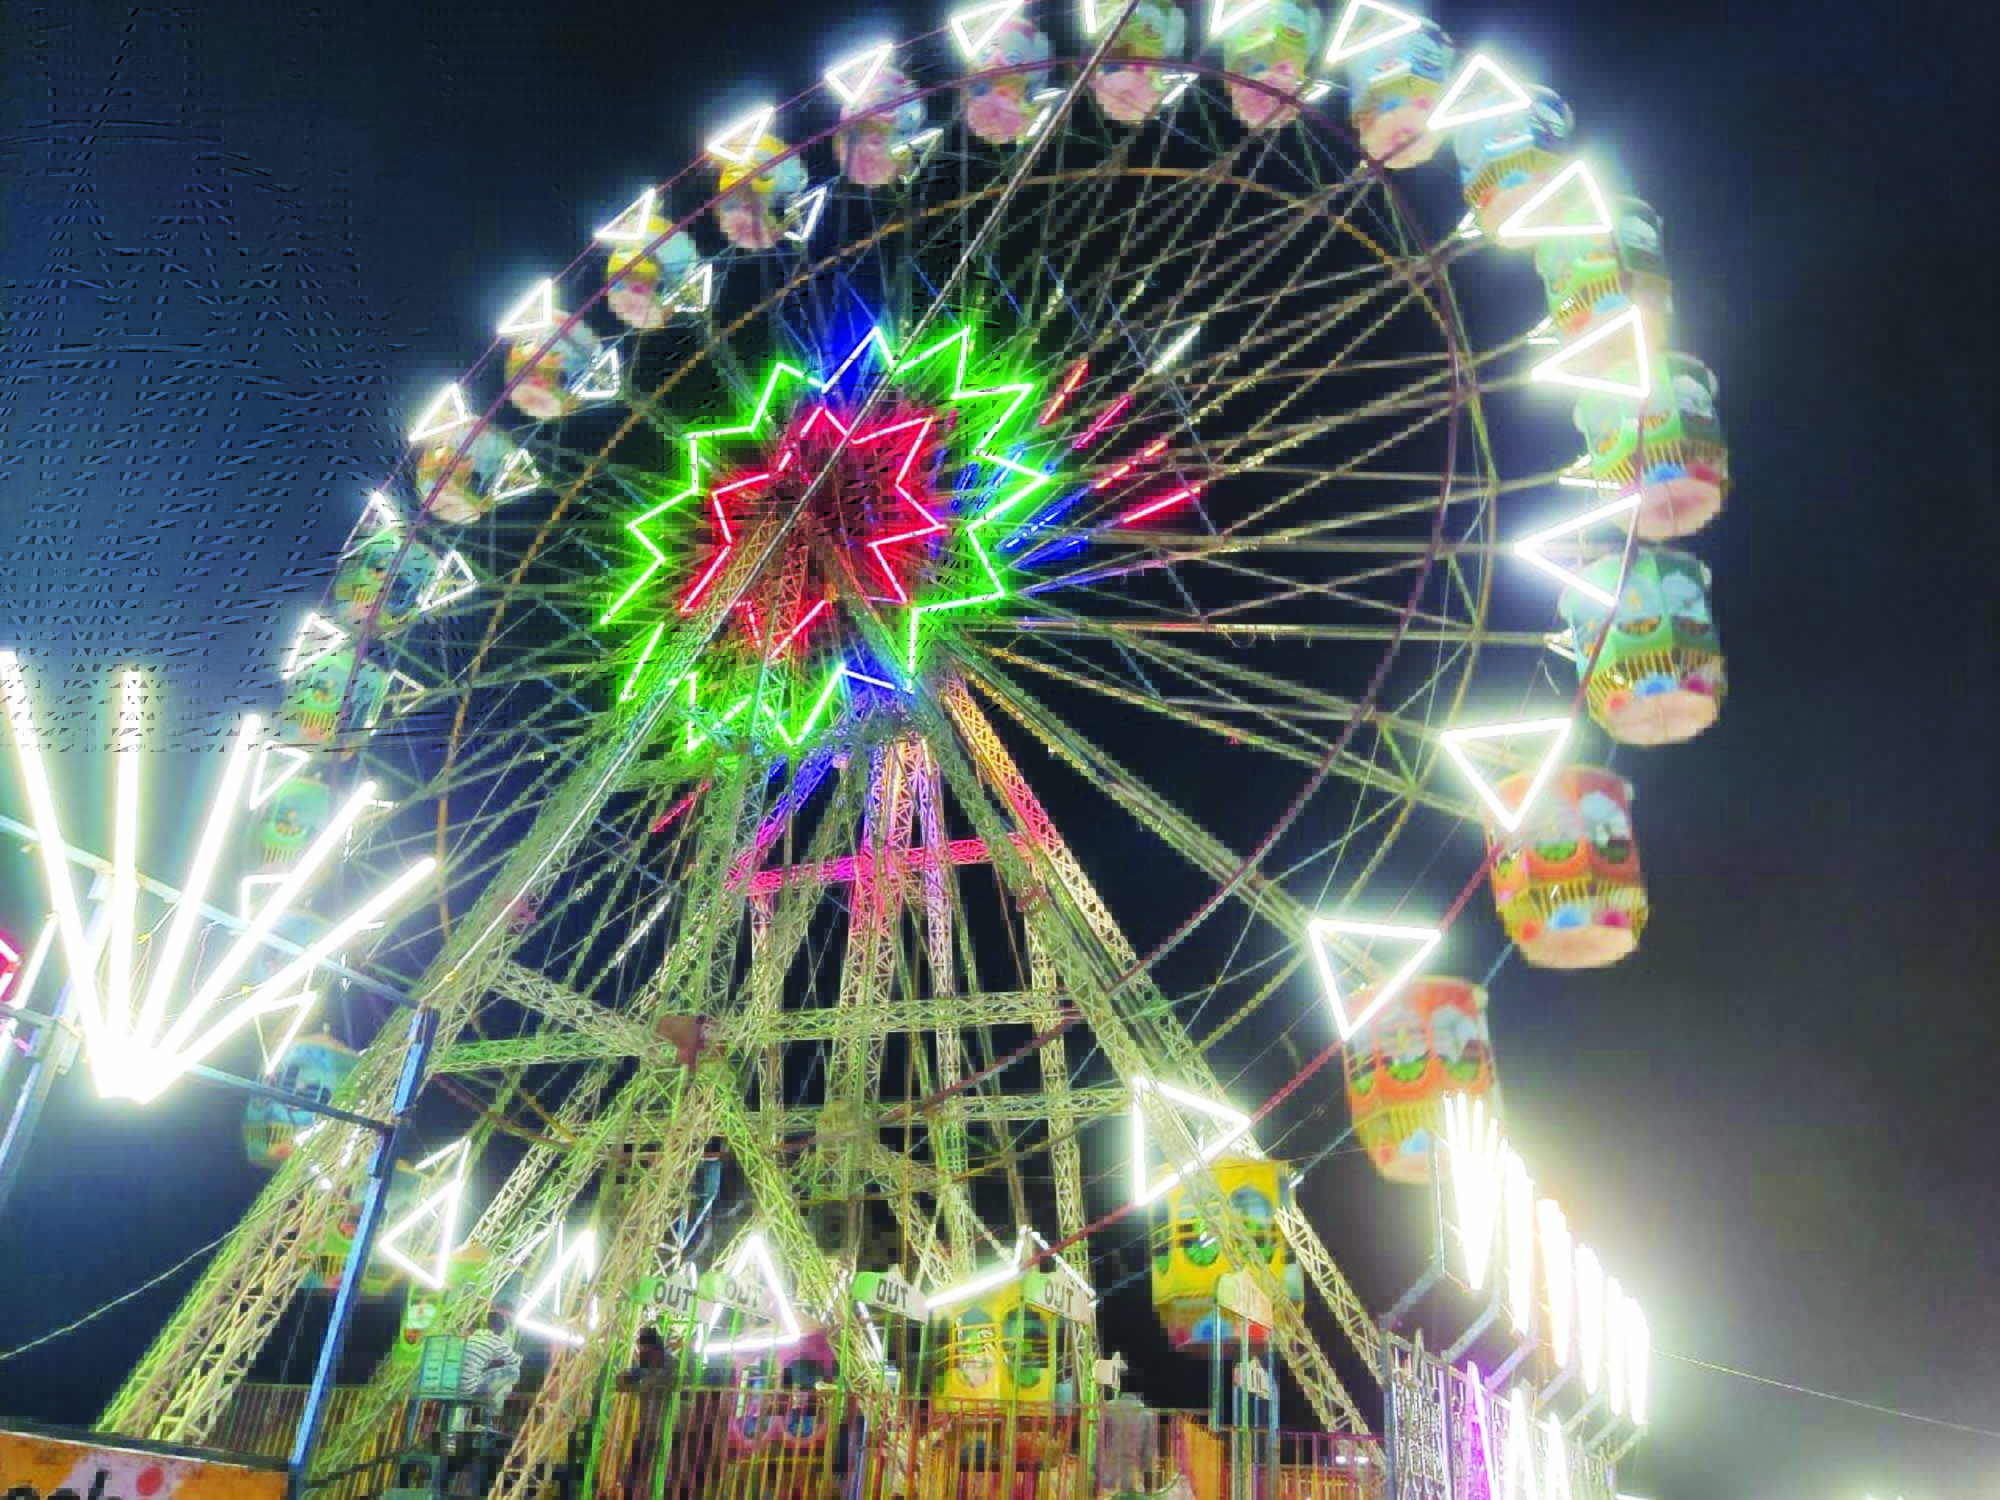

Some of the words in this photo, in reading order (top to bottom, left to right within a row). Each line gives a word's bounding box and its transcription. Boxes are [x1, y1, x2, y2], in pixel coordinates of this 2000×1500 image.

[654, 1280, 697, 1311] OUT
[876, 1279, 908, 1310] OUT
[1045, 1280, 1073, 1313] OUT
